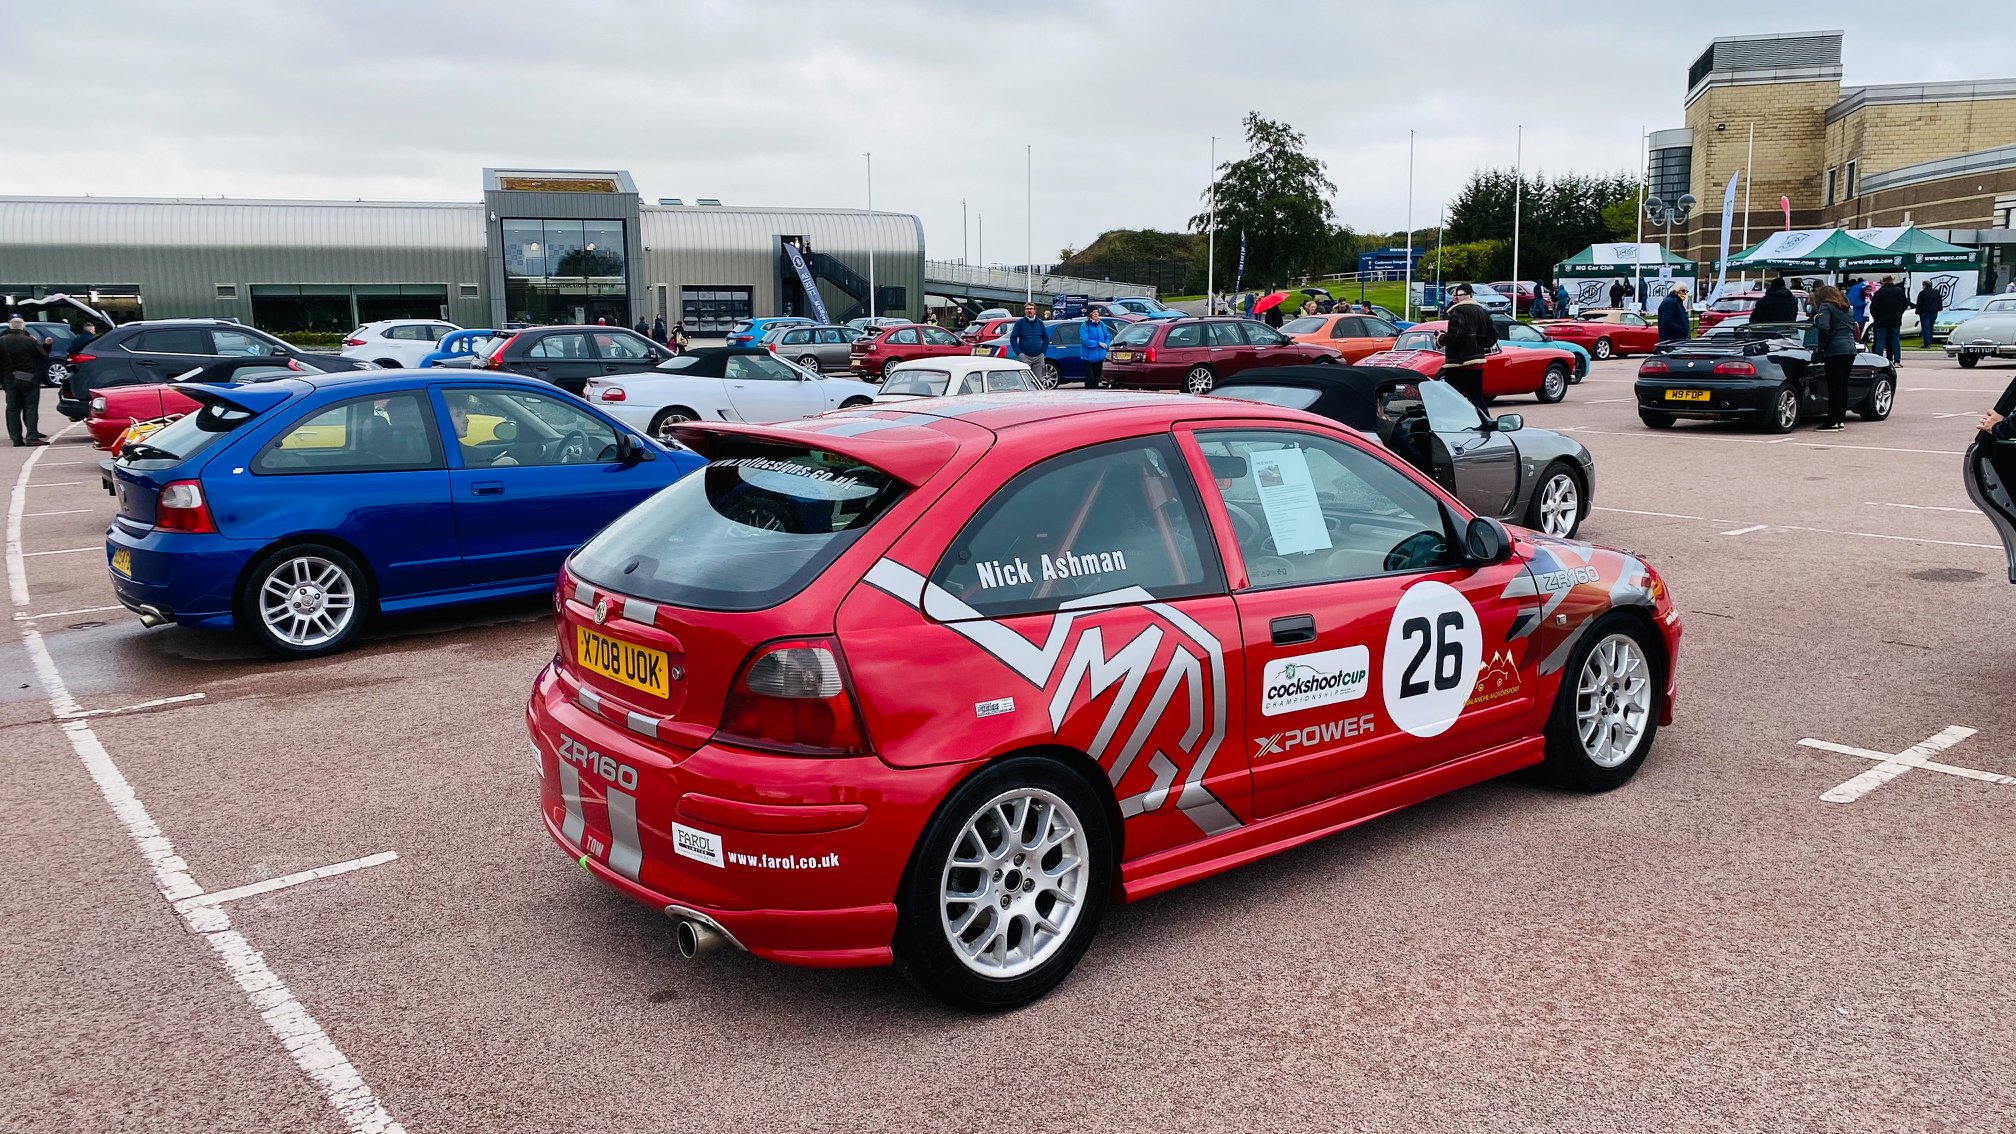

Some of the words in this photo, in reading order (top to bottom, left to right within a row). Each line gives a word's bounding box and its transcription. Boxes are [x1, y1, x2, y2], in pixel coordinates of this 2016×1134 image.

[1672, 390, 1684, 399] M9
[1685, 390, 1704, 400] FDP
[706, 456, 858, 490] www.reflecsigns.couk
[975, 557, 1033, 589] Nick
[1040, 550, 1127, 581] Ashman
[1543, 565, 1600, 591] ZR160
[582, 630, 621, 675] X708
[625, 646, 661, 690] UOK
[1400, 610, 1464, 700] 26
[1265, 690, 1339, 710] CHAMPIONSHIP
[1253, 714, 1375, 759] XPOWER
[558, 732, 639, 792] ZR160
[587, 835, 605, 858] TOW
[678, 829, 715, 852] FAROL
[727, 851, 840, 870] www.farol.co.uk
